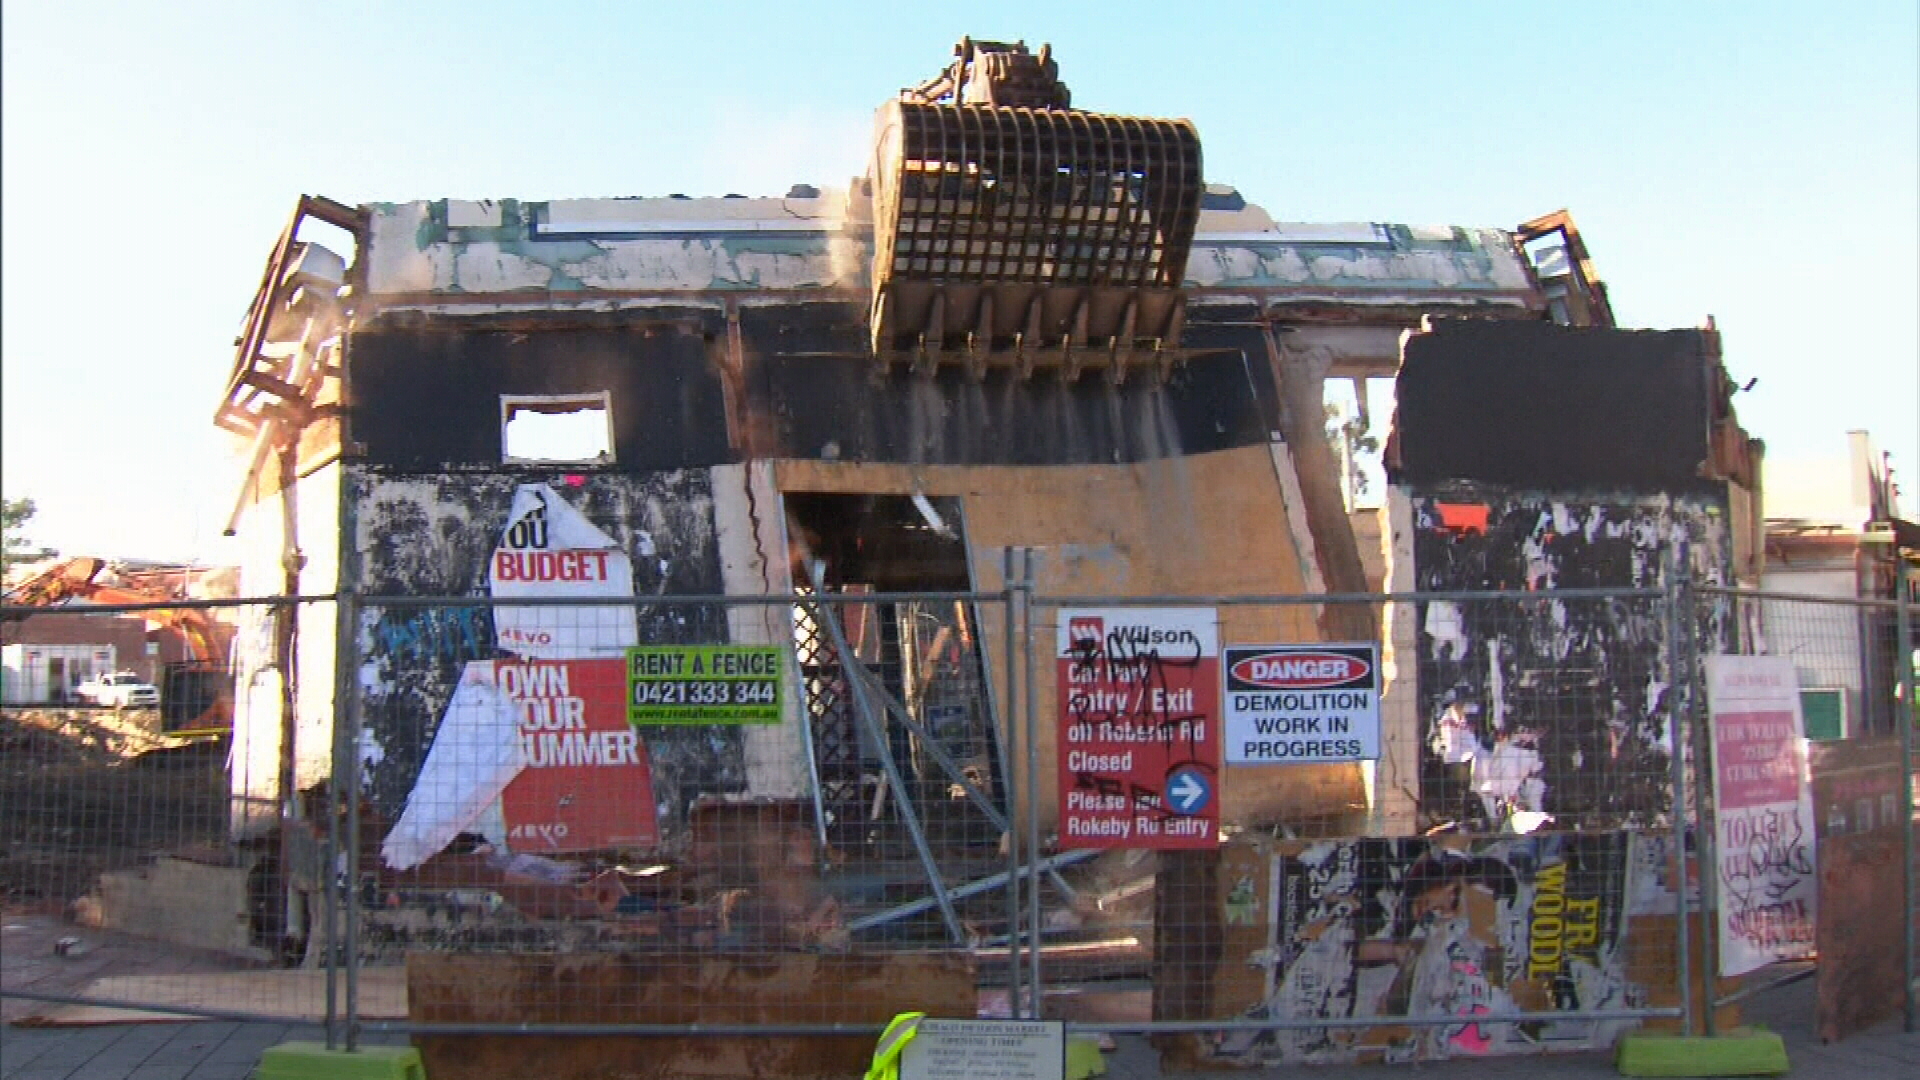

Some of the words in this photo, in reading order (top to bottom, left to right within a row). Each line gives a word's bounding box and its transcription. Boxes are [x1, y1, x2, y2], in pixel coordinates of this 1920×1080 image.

[501, 508, 548, 548] OU
[496, 551, 609, 582] BUDGET
[1113, 625, 1194, 644] Wilson
[633, 653, 685, 675] RENT
[693, 653, 704, 675] A
[712, 653, 776, 675] FENCE
[1068, 663, 1100, 683] Car
[1250, 659, 1350, 680] DANGER
[500, 665, 570, 698] OWN
[735, 681, 776, 704] 344
[1068, 687, 1128, 717] Entry
[1152, 687, 1194, 712] Exit
[1234, 693, 1369, 712] DEMOLITION
[1180, 720, 1206, 743] Rd
[1254, 717, 1321, 735] WORK
[1328, 716, 1349, 733] IN
[1244, 739, 1362, 758] PROGRESS
[1068, 751, 1133, 771] Closed
[1067, 791, 1125, 811] Please
[1068, 815, 1131, 839] Rokeby
[1136, 815, 1160, 835] Rd
[1164, 816, 1210, 839] Entry
